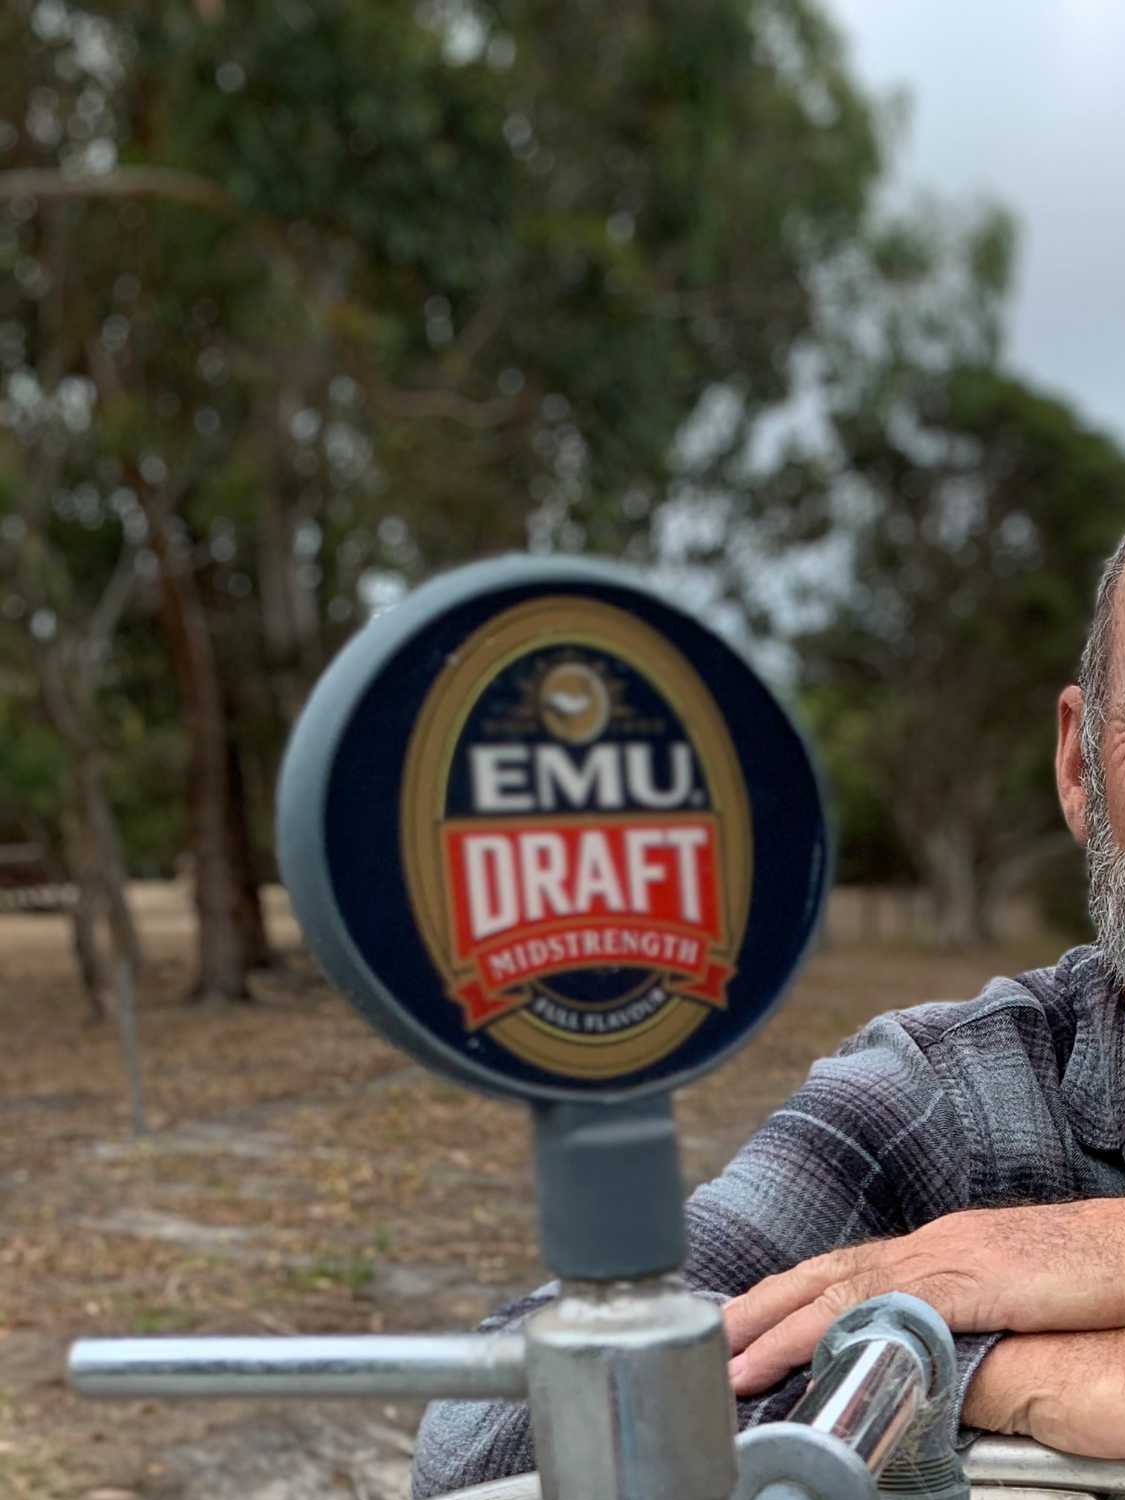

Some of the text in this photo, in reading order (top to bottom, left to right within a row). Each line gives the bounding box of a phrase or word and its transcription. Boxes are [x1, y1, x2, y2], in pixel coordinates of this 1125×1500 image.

[469, 742, 695, 813] EMU
[464, 827, 709, 939] DRAFT
[487, 928, 699, 980] MIDSTRENGTH
